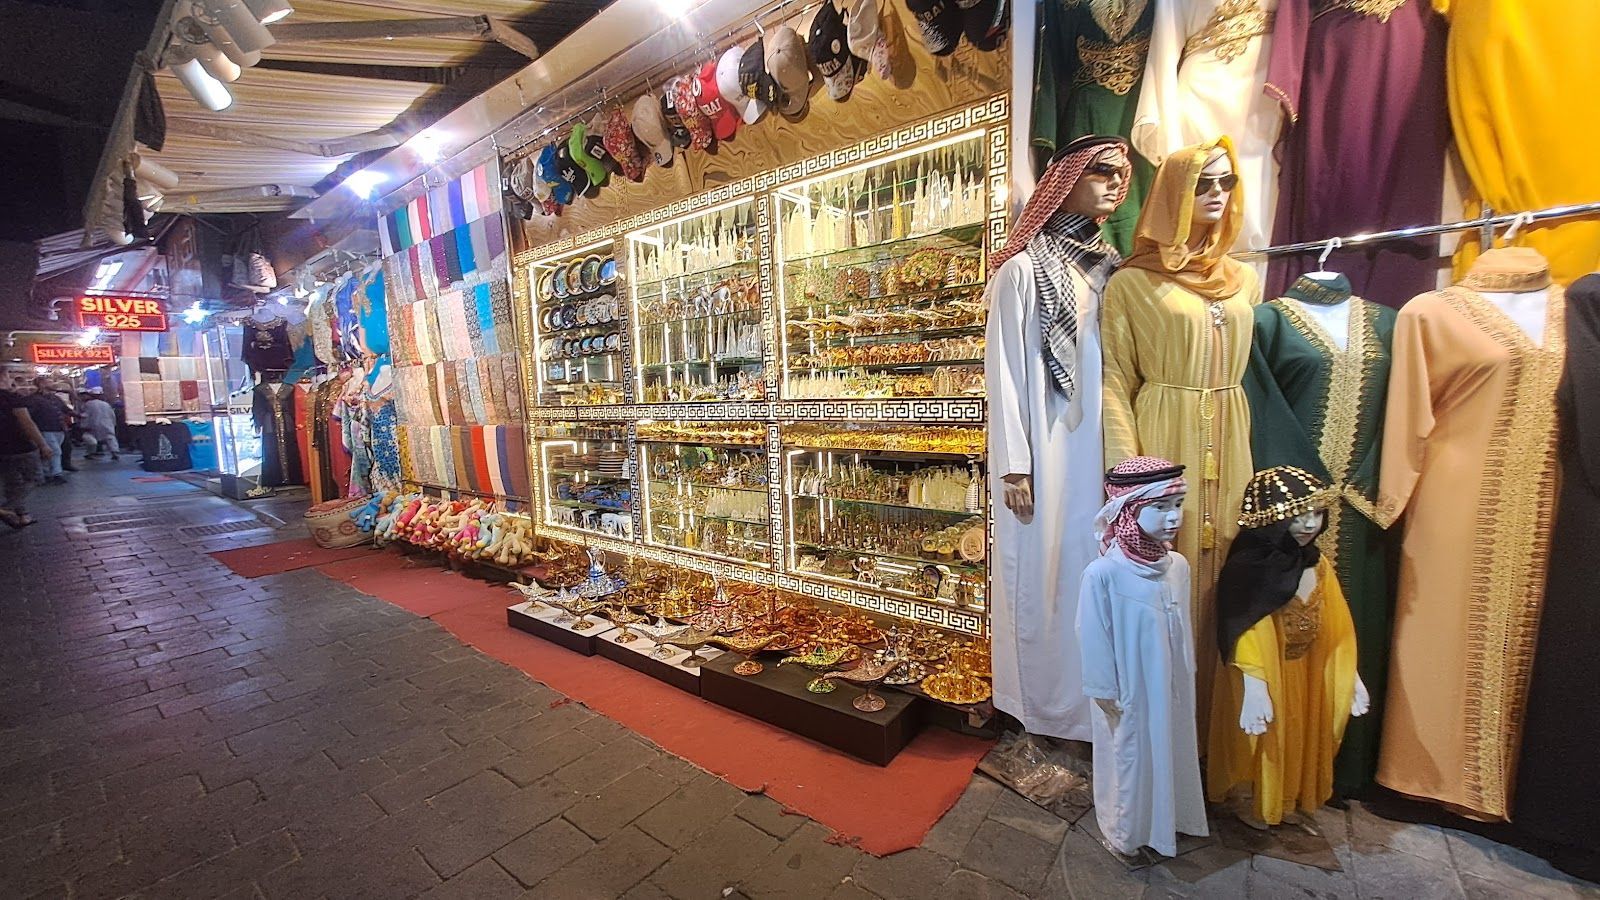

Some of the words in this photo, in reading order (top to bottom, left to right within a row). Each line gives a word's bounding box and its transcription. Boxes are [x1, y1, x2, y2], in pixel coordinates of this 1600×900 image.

[80, 297, 162, 315] SILVER
[104, 314, 141, 328] 925
[38, 349, 84, 359] SILVER
[86, 349, 110, 358] 925
[229, 406, 253, 415] SILV
